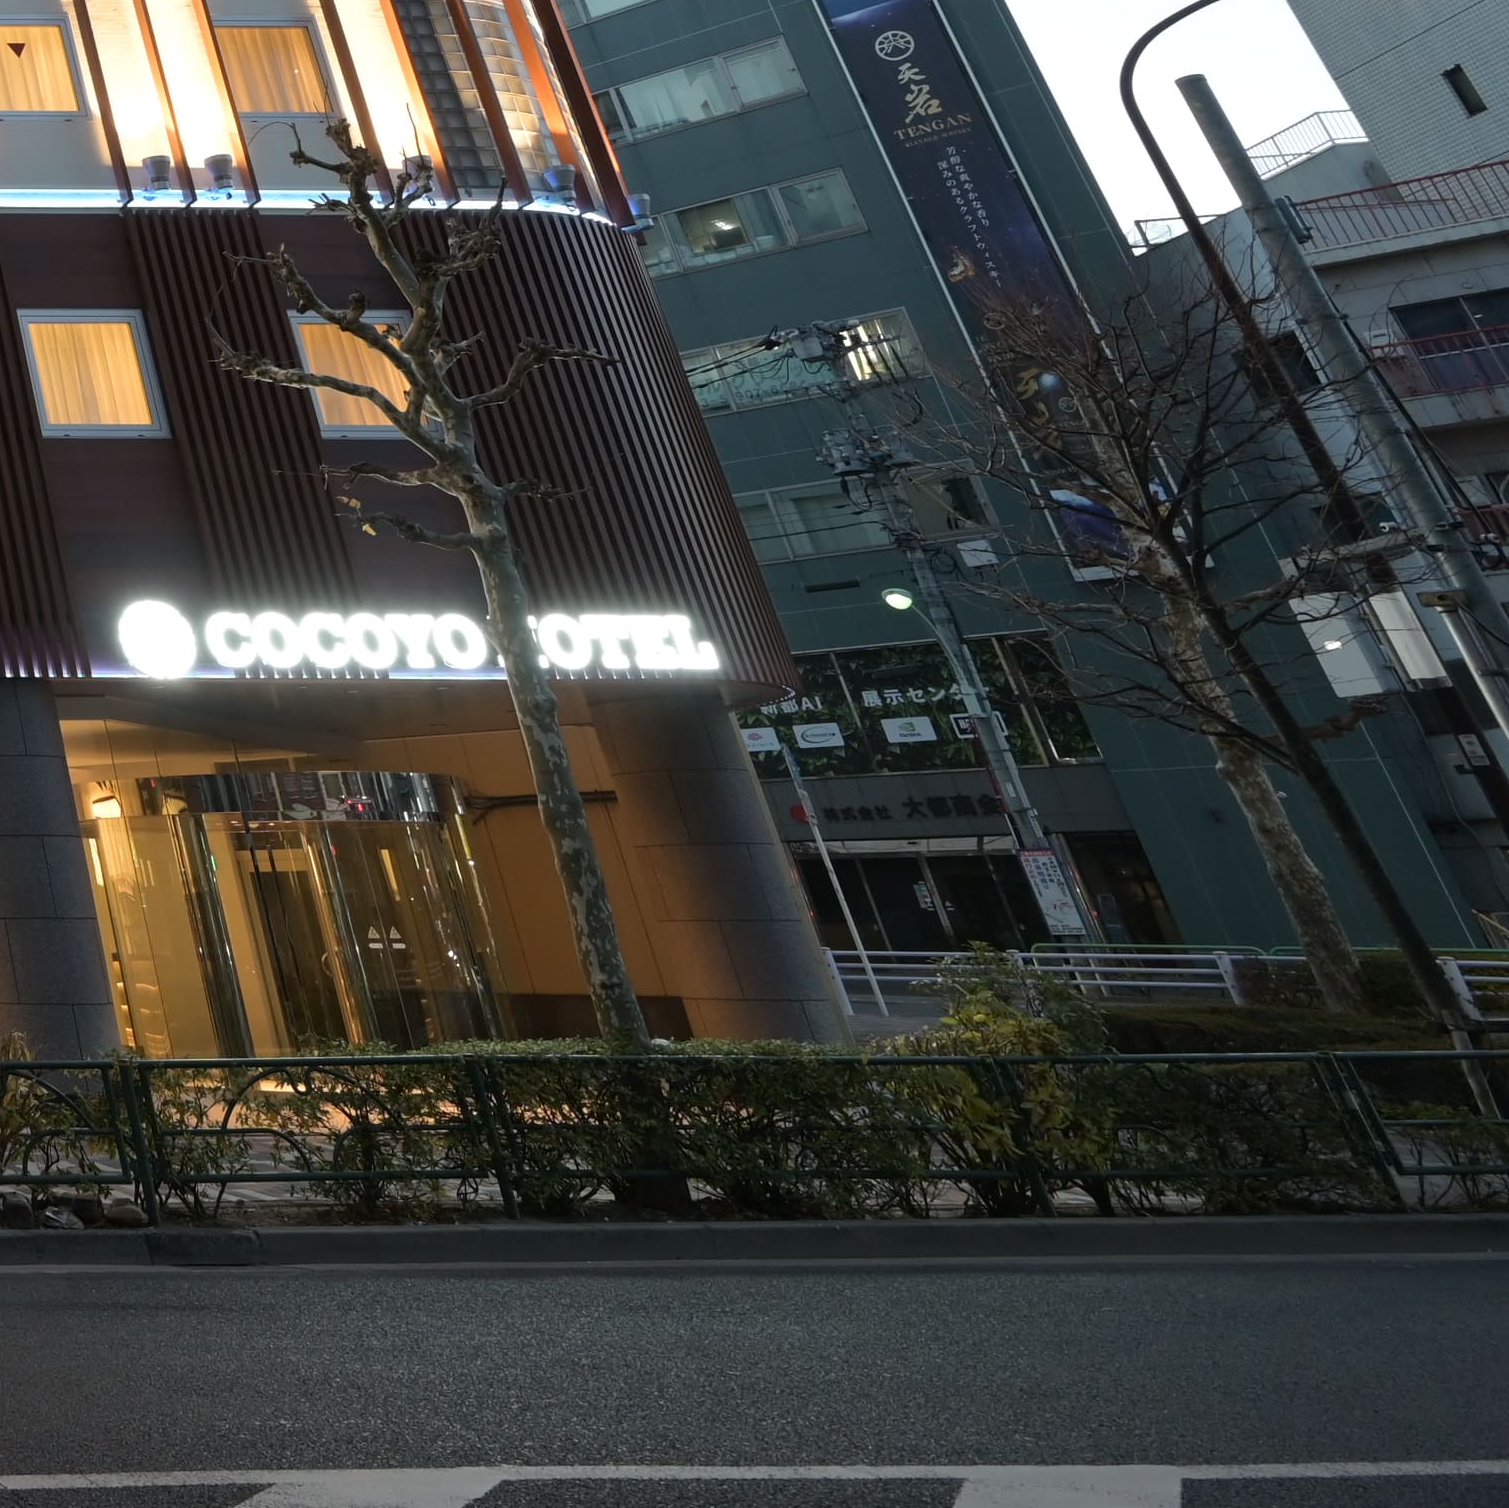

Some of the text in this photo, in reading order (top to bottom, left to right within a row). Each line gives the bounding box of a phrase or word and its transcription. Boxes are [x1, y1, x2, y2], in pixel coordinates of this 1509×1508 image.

[893, 112, 972, 141] TENGAN
[204, 611, 719, 670] COCOYO OTEL
